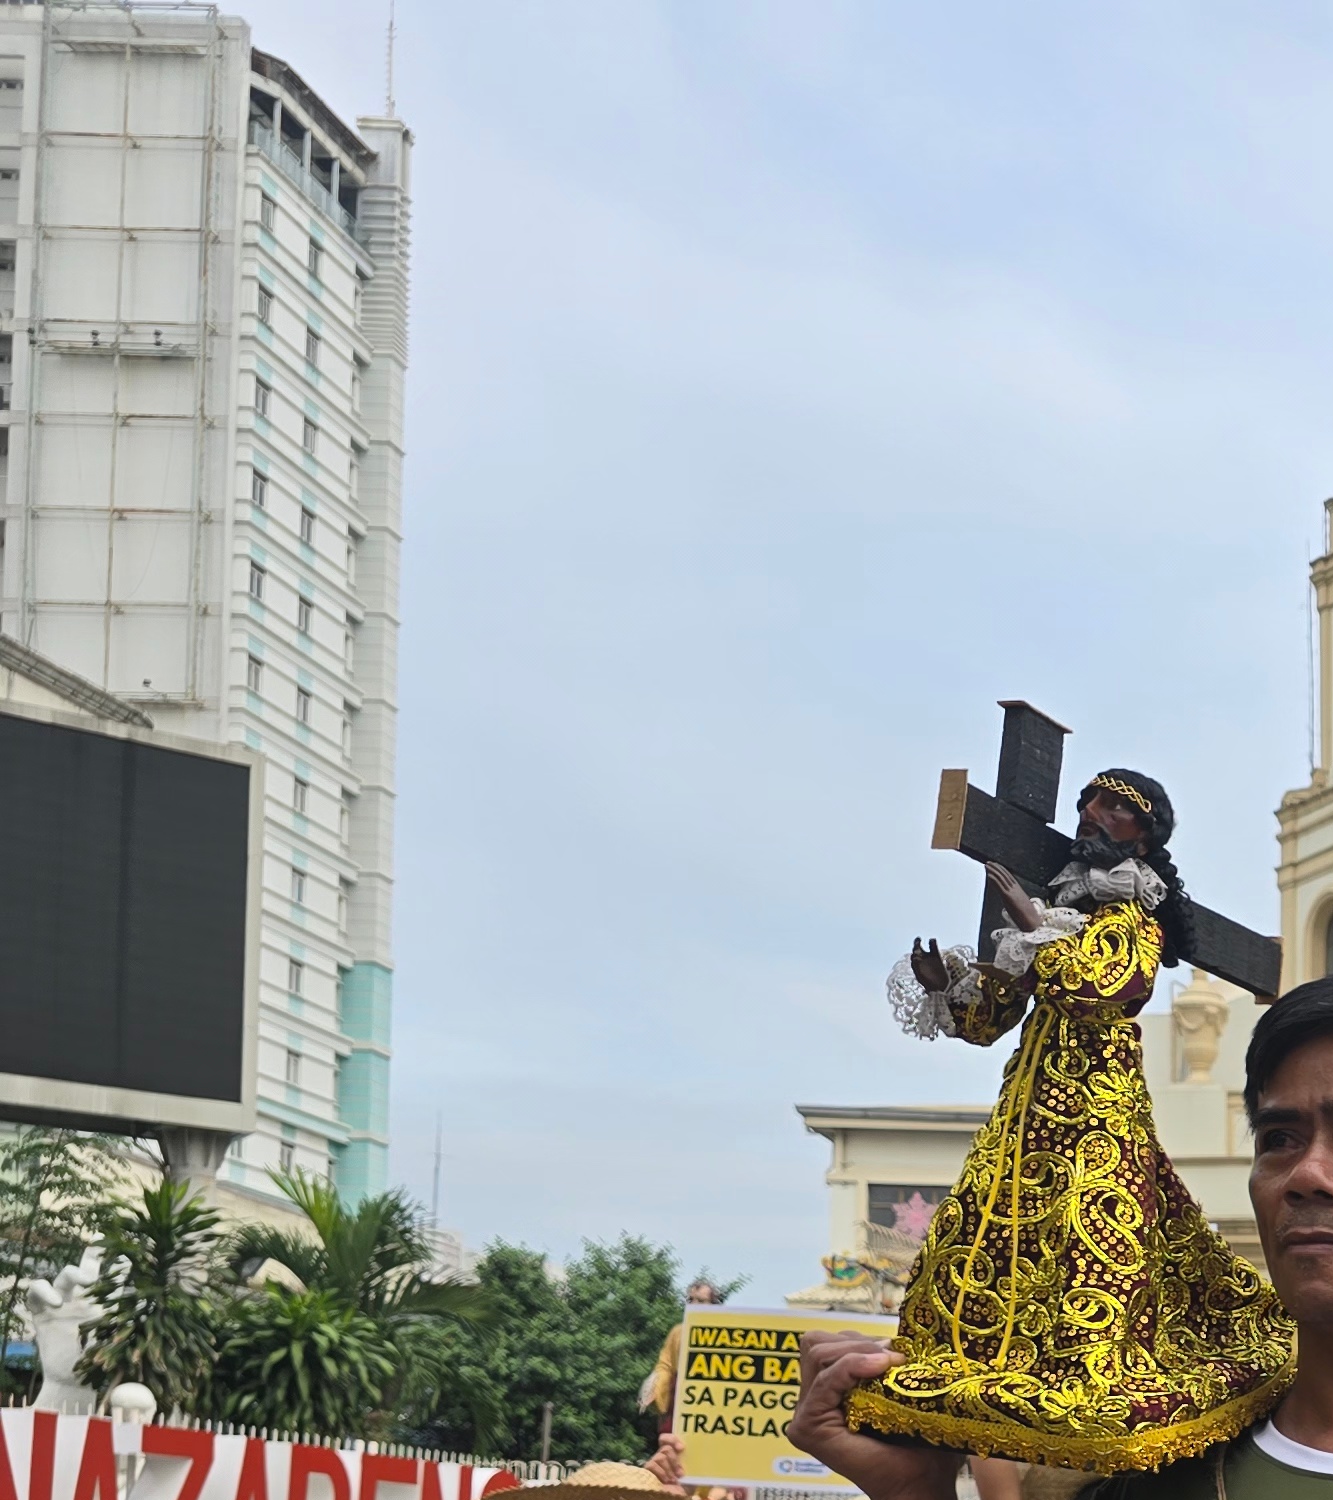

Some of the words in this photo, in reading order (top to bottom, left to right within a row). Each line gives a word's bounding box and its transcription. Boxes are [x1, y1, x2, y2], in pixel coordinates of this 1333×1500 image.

[691, 1327, 776, 1349] IWASAN
[688, 1353, 756, 1381] ANG
[685, 1385, 715, 1406] SA
